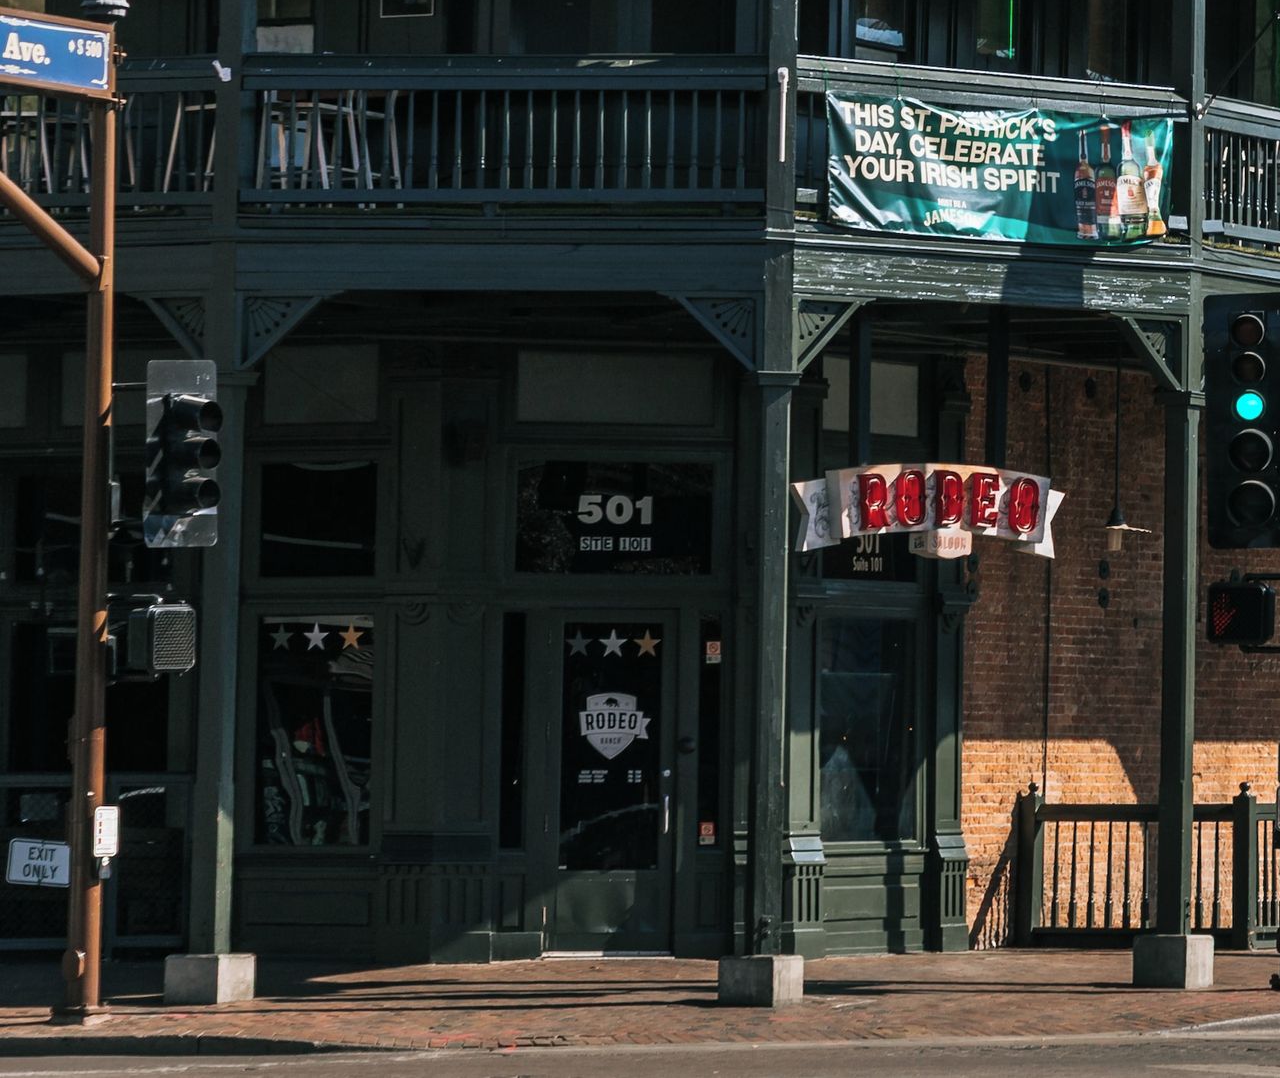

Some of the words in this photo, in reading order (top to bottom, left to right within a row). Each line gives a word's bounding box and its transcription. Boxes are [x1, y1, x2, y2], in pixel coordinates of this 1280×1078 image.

[2, 32, 51, 65] Ave.
[76, 38, 85, 56] S
[839, 101, 895, 128] THIS
[899, 105, 932, 133] ST.
[939, 114, 1057, 142] PATRICK'S
[854, 129, 902, 161] DAY,
[908, 133, 1046, 167] CELEBRATE
[843, 154, 915, 183] YOUR
[919, 160, 978, 190] IRISH
[983, 166, 1061, 194] SPIRIT
[577, 495, 653, 525] 501
[858, 469, 1041, 536] RODEO
[580, 535, 614, 552] STE
[619, 536, 652, 552] 101
[871, 555, 883, 572] 101
[585, 712, 638, 731] RODEO
[28, 845, 57, 862] EXIT
[22, 864, 59, 880] ONLY
